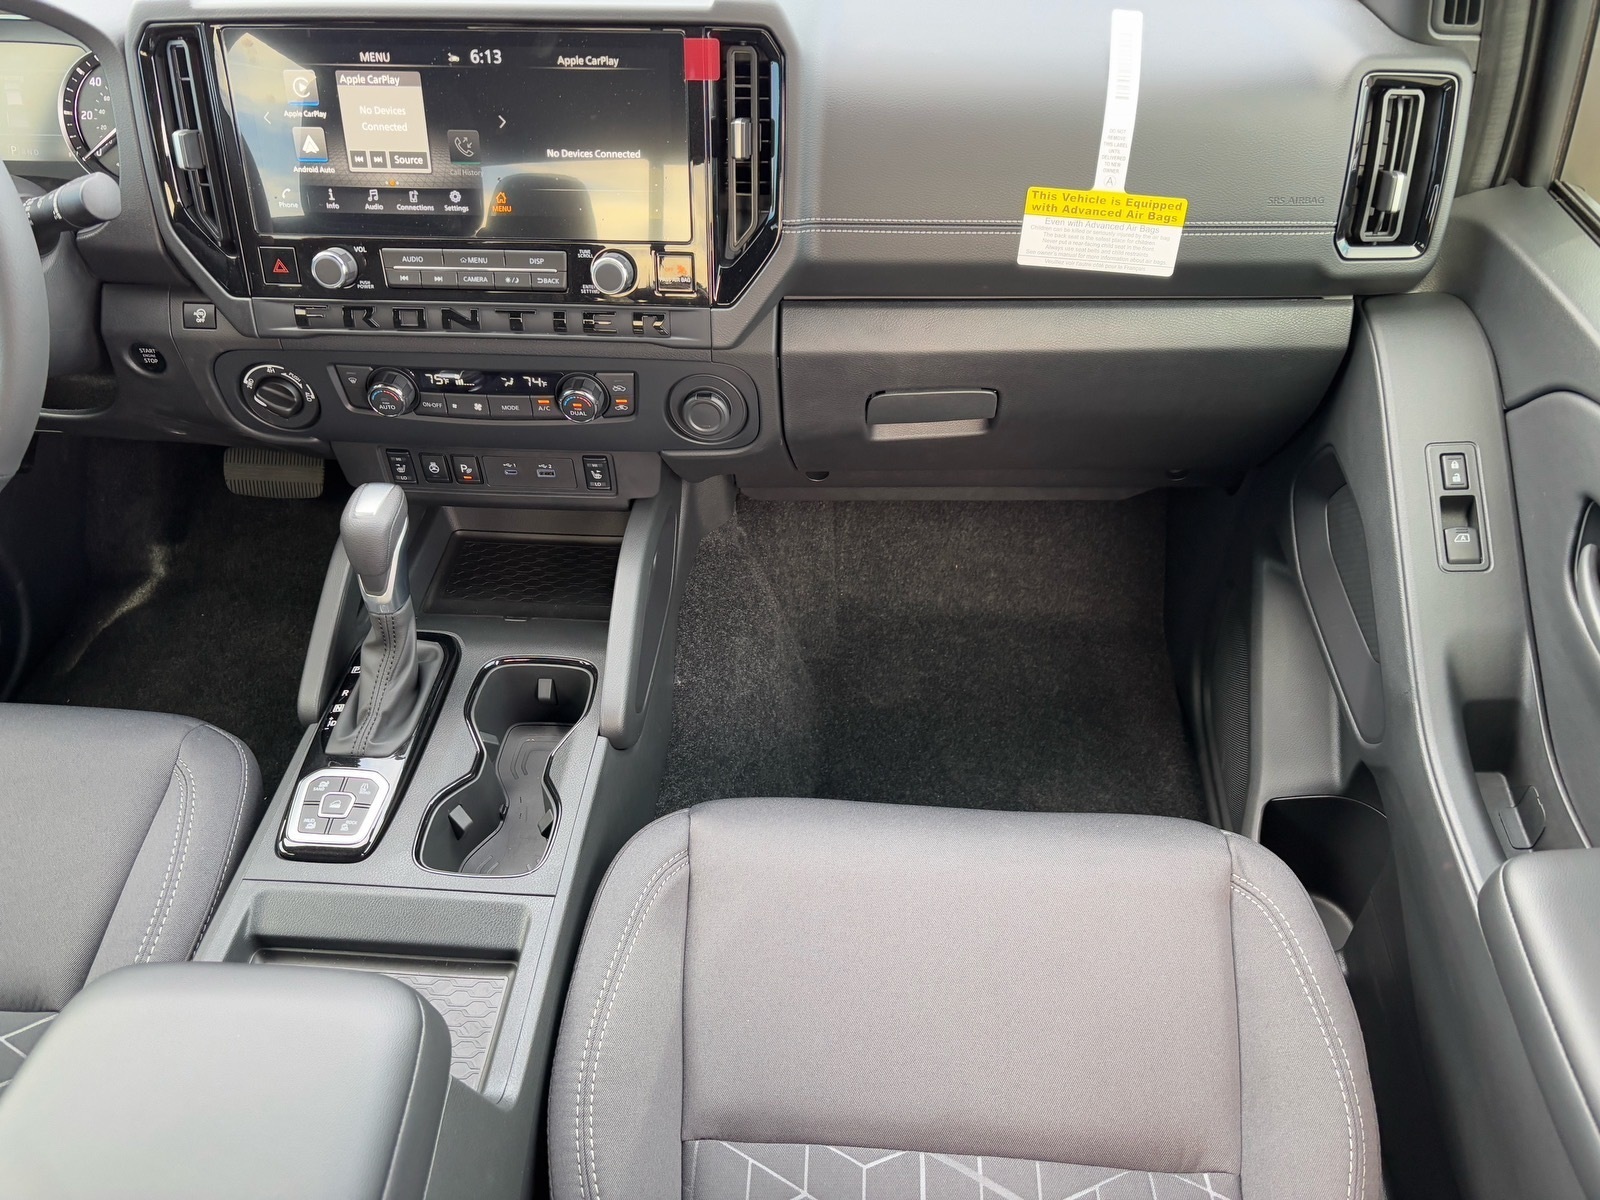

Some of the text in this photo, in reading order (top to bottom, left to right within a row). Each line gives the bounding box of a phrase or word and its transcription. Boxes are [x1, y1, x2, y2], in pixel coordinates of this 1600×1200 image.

[359, 51, 391, 63] MENU
[470, 49, 502, 64] 6:13
[557, 55, 619, 68] Apple CarPlay
[89, 77, 102, 87] 40
[339, 74, 400, 87] Apple CarPlay
[81, 110, 93, 120] 20
[283, 110, 327, 119] Apple CarPlay
[359, 105, 406, 116] No Devices
[361, 121, 408, 132] Connected
[546, 149, 641, 159] No Devices Connected
[394, 155, 424, 165] Source
[293, 166, 336, 174] Android Auto
[1031, 190, 1183, 212] This Vehicle is Equipped
[1267, 196, 1324, 204] SRS AIRBAG
[326, 202, 340, 210] Info
[365, 203, 384, 211] Audio
[396, 203, 435, 212] Connections
[444, 204, 470, 213] Settings
[492, 205, 512, 213] MENU
[1031, 202, 1178, 224] with Advanced Air Bags
[1045, 217, 1065, 226] Even
[1067, 220, 1083, 228] with
[1085, 221, 1125, 231] Advanced
[1139, 225, 1160, 235] Bags
[1093, 229, 1116, 238] seriously
[1044, 244, 1063, 252] Always
[467, 256, 488, 264] MENU
[529, 257, 545, 265] DISP
[1100, 254, 1129, 262] information
[543, 277, 560, 285] BACK
[294, 304, 671, 337] FRONTIER
